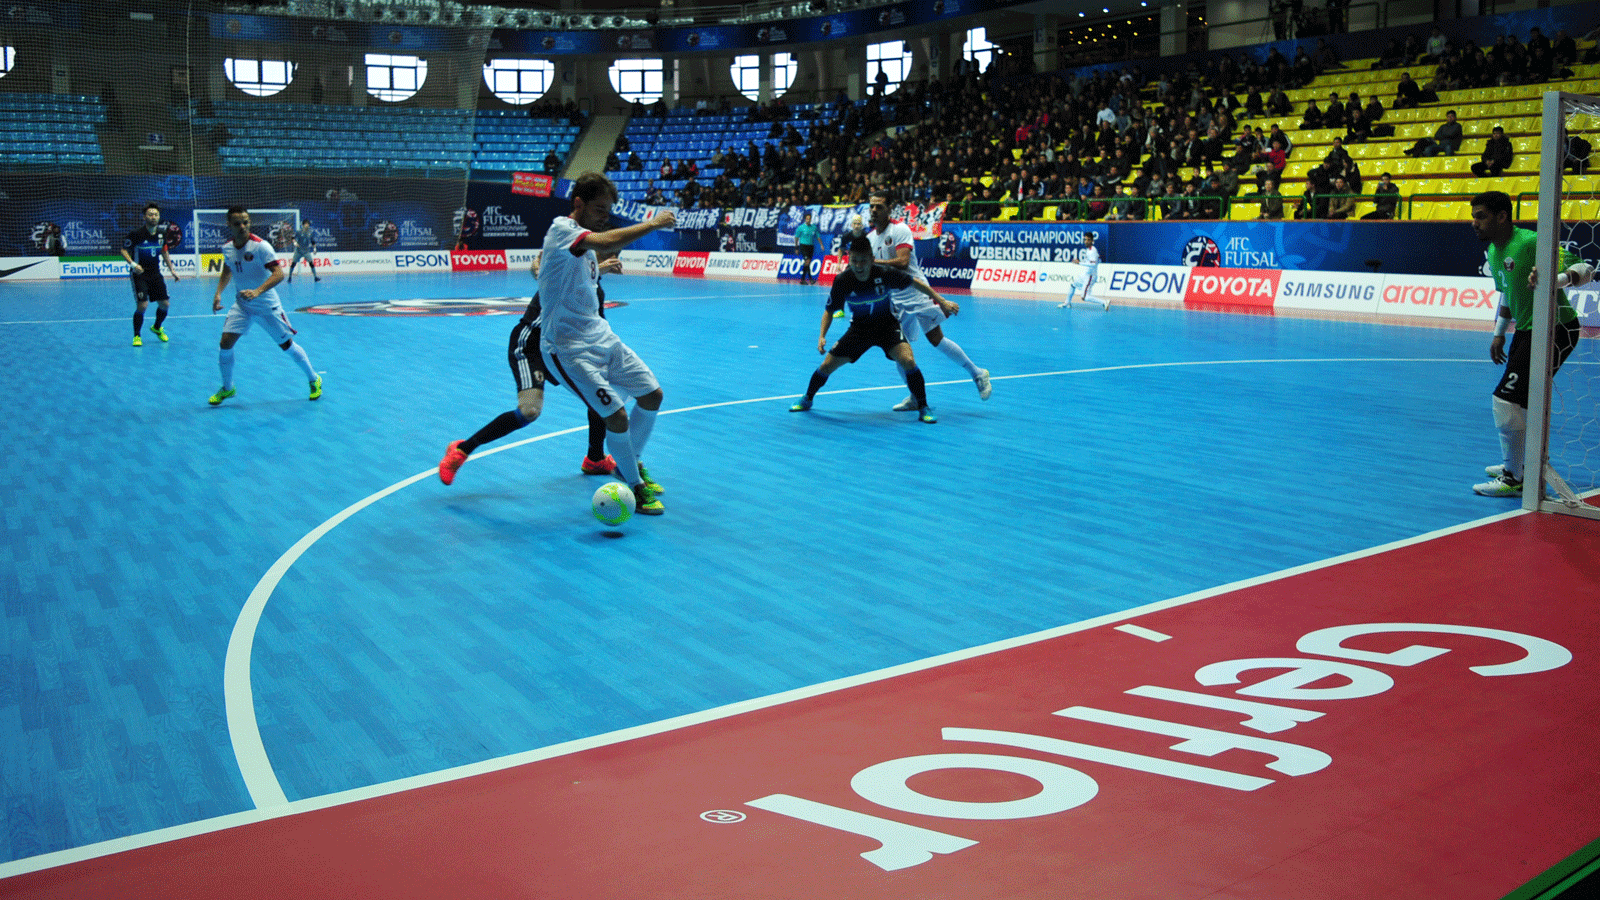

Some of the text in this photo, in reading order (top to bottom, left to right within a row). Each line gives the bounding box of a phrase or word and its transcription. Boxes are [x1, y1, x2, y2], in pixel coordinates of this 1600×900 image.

[482, 206, 501, 215] AFC
[482, 215, 524, 225] FUTSAL
[64, 230, 106, 239] FUTSAL
[401, 228, 433, 236] FUTSAL
[961, 230, 979, 242] AFC
[981, 231, 1016, 244] FUTSAL
[735, 242, 757, 251] FUTSAL
[1225, 237, 1249, 250] AFC
[395, 254, 448, 267] EPSON
[452, 254, 505, 265] TOYOTA
[970, 246, 1087, 262] UZBEKISTAN 2016
[1224, 252, 1279, 267] FUTSAL
[645, 254, 674, 268] EPSON
[676, 256, 706, 269] TOYOTA
[708, 258, 740, 269] SAMSUNG
[742, 259, 779, 271] aramex
[62, 264, 130, 275] FamilyMart
[950, 267, 974, 280] CARD
[975, 268, 1037, 283] TOSHIBA
[1110, 271, 1185, 294] EPSON
[1192, 275, 1273, 297] TOYOTA
[1283, 281, 1375, 301] SAMSUNG
[1382, 284, 1496, 309] aramex
[1505, 372, 1519, 390] 2
[596, 388, 612, 406] 8
